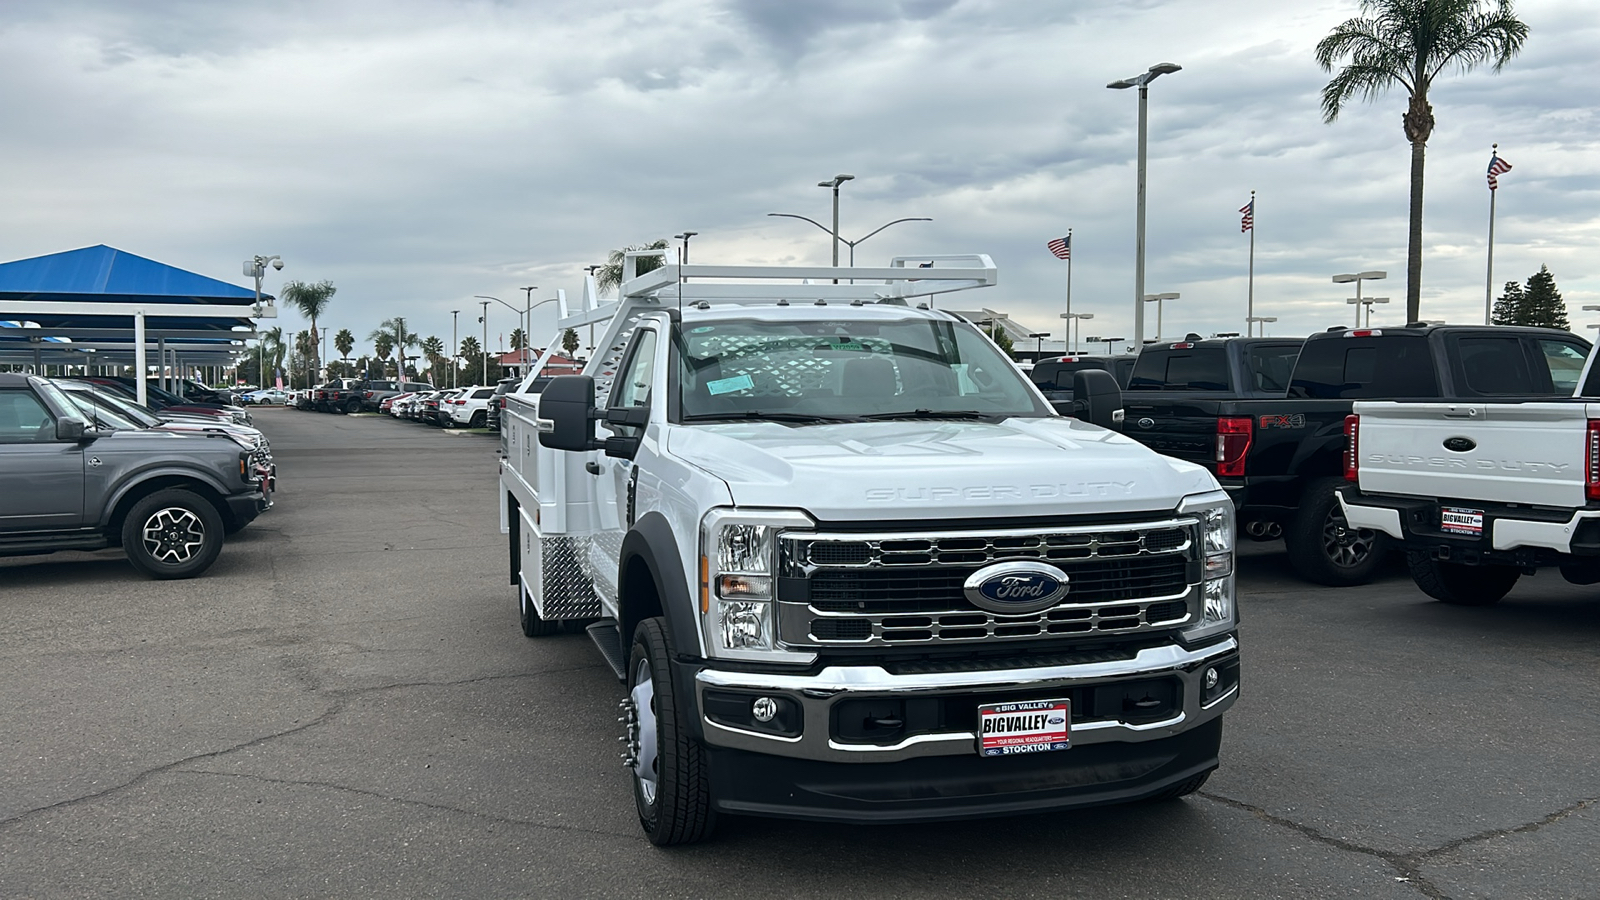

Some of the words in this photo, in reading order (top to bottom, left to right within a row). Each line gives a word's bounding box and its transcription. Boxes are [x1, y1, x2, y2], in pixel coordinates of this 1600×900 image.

[1259, 413, 1306, 429] FX4
[1369, 454, 1467, 467] SUPER
[1476, 459, 1569, 473] DUTY
[865, 485, 1022, 502] SUPER
[1029, 480, 1136, 498] DUTY
[1443, 514, 1474, 524] BIGVALLEY
[996, 576, 1045, 598] Ford
[1018, 702, 1049, 710] VALLEY
[983, 714, 1049, 733] BIGVALLEY
[1002, 743, 1051, 754] STOCKTON
